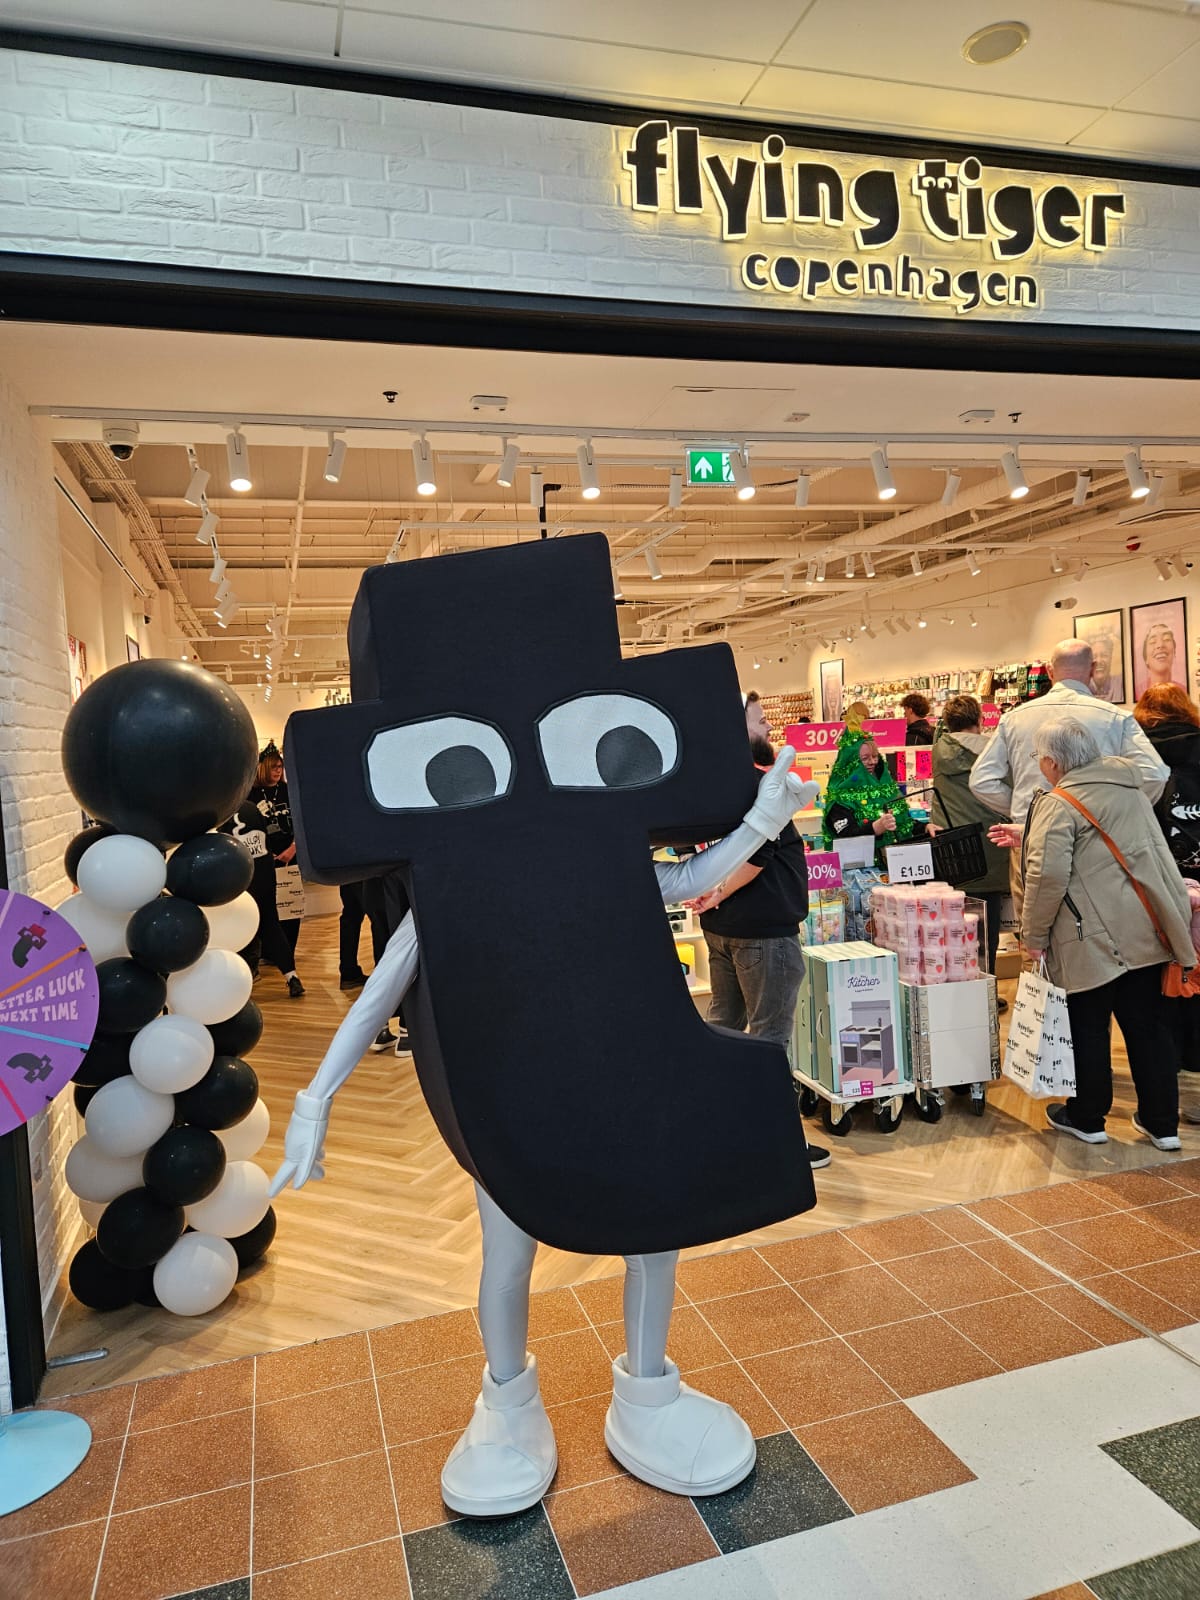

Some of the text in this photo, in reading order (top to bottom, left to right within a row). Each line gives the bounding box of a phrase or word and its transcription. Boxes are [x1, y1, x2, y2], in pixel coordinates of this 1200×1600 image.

[626, 119, 1126, 260] flying tiger
[742, 253, 1038, 314] copenhagen
[805, 729, 843, 746] 30%
[807, 863, 837, 881] 30%
[900, 865, 931, 878] £1.50
[0, 968, 86, 1010] ETTER LUCK
[847, 976, 881, 989] Kitchen
[0, 1000, 79, 1023] NEXT TIME
